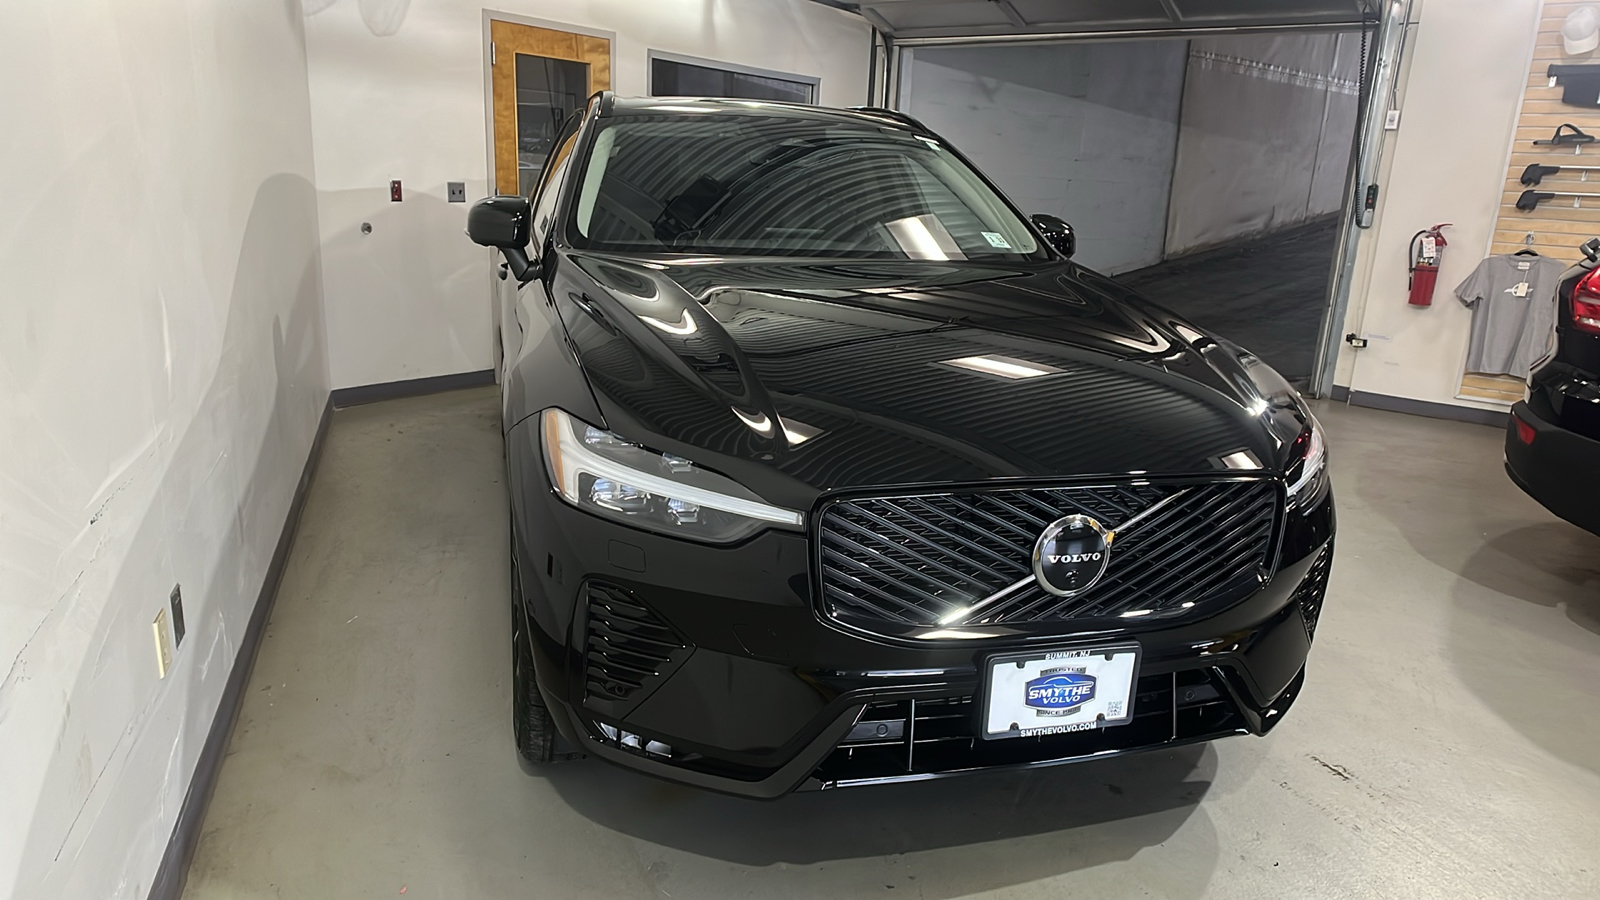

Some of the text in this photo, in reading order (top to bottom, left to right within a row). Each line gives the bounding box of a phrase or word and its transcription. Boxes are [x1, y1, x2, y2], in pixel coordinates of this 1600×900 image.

[1047, 552, 1101, 564] VOLVO
[1028, 685, 1091, 700] SMYTHE
[1042, 695, 1081, 704] VOLVO
[1020, 721, 1097, 737] SMYTHEVOLVO.COM
